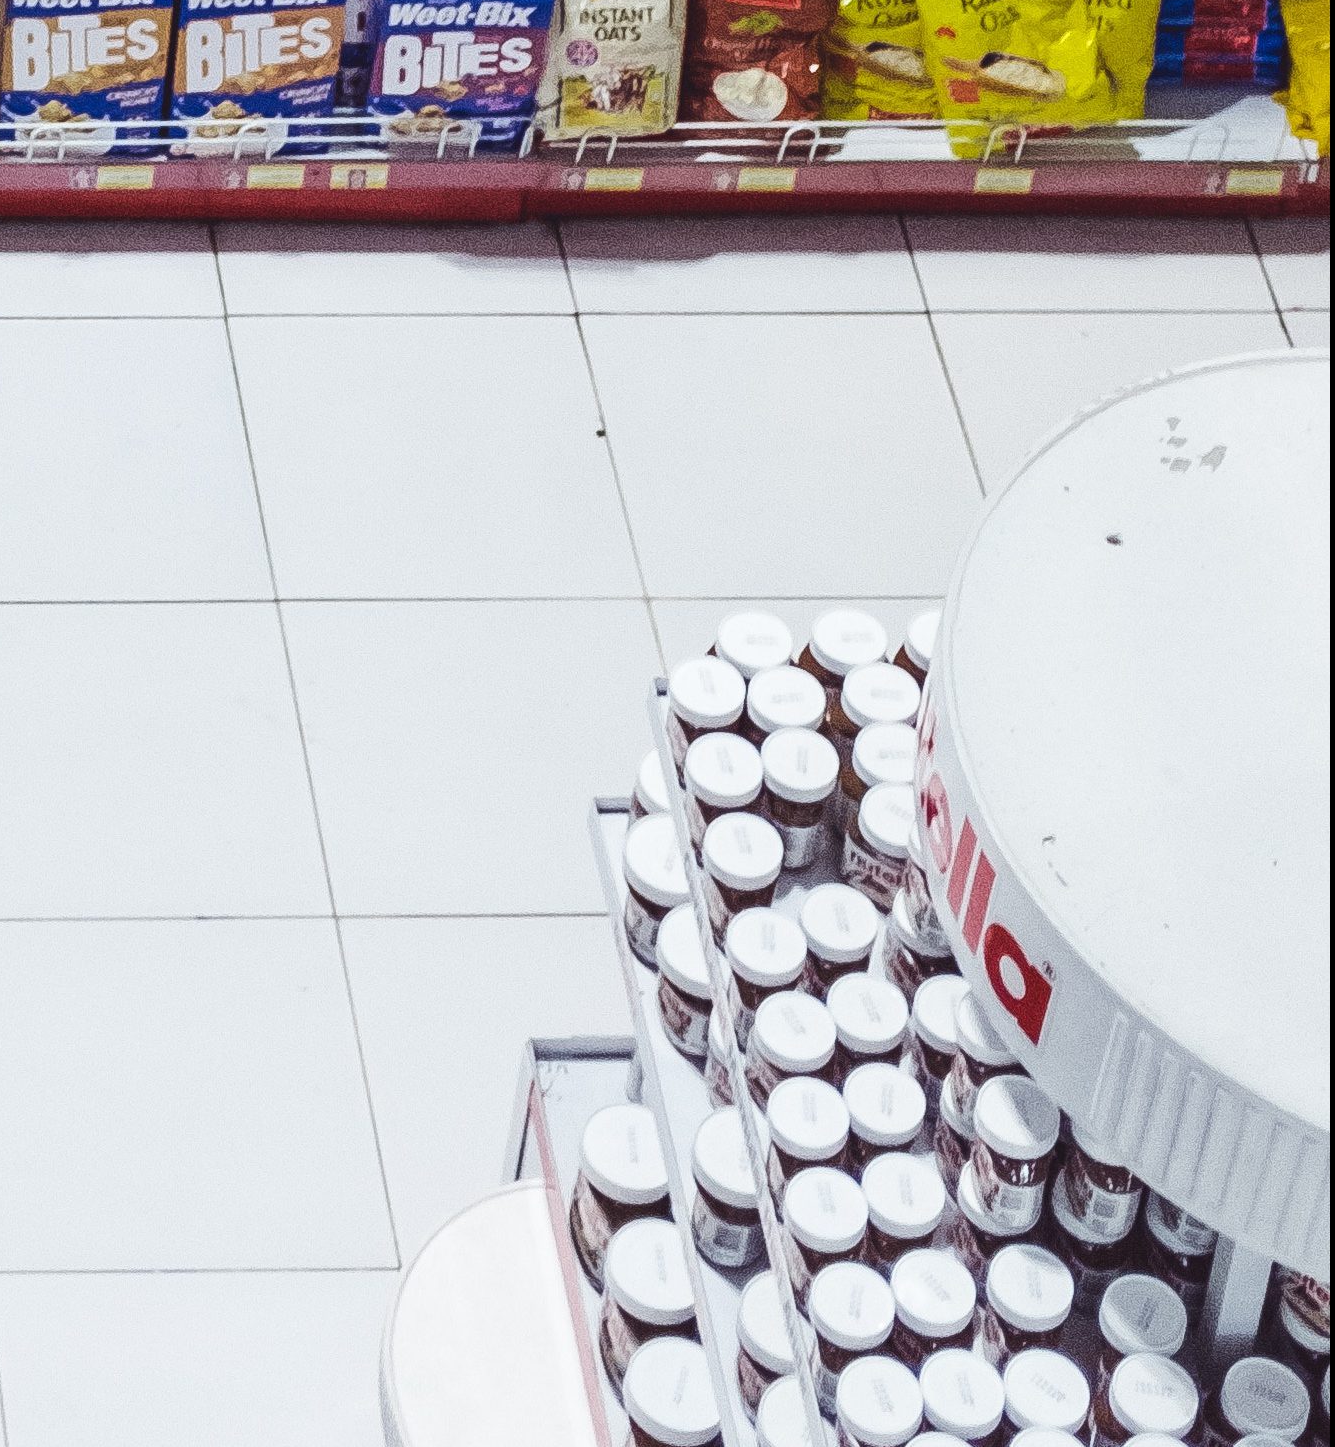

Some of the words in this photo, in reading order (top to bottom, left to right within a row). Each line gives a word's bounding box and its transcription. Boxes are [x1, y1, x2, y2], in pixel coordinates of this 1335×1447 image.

[389, 2, 535, 27] Weet-Bix
[580, 7, 653, 28] INSTANT
[594, 26, 641, 42] OATS
